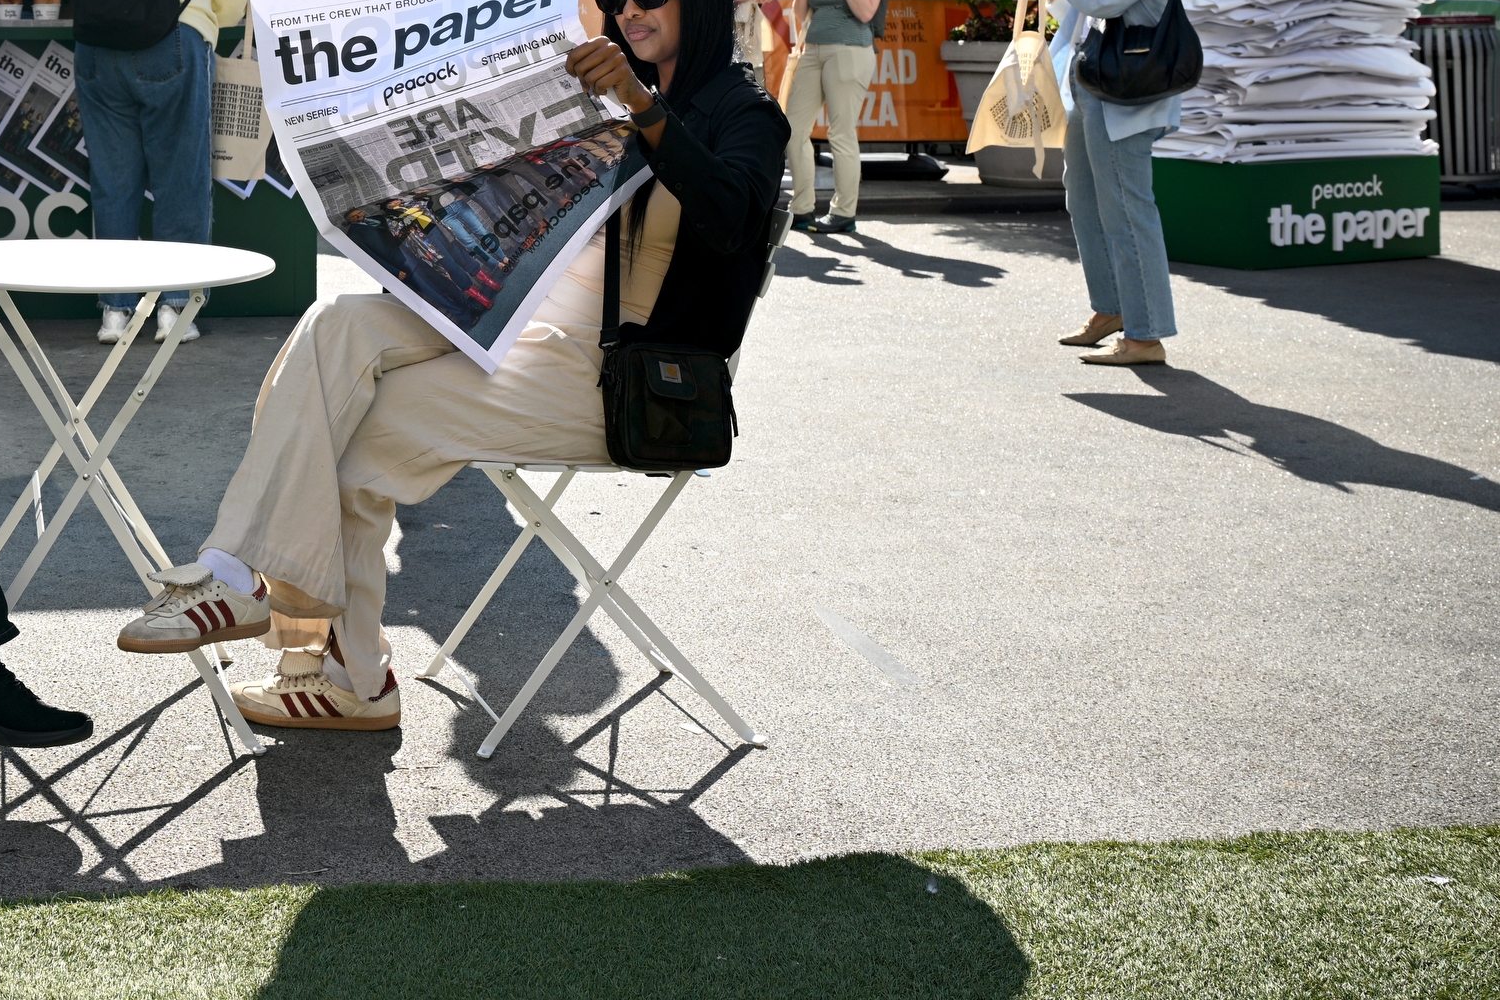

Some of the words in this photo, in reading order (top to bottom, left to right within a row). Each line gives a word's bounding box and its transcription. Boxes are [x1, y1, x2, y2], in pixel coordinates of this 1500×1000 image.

[269, 15, 301, 29] FROM
[304, 11, 326, 23] THE
[329, 6, 362, 20] CREW
[364, 1, 392, 13] THAT
[901, 19, 924, 30] York
[481, 39, 540, 66] STREAMING
[540, 30, 567, 48] NOW
[901, 32, 927, 43] York.
[45, 55, 71, 79] the
[274, 29, 378, 86] the
[383, 61, 458, 107] peacock
[284, 112, 305, 128] NEW
[306, 104, 339, 121] SERIES
[1311, 174, 1383, 210] peacock
[1267, 204, 1326, 247] the
[1332, 207, 1430, 251] paper
